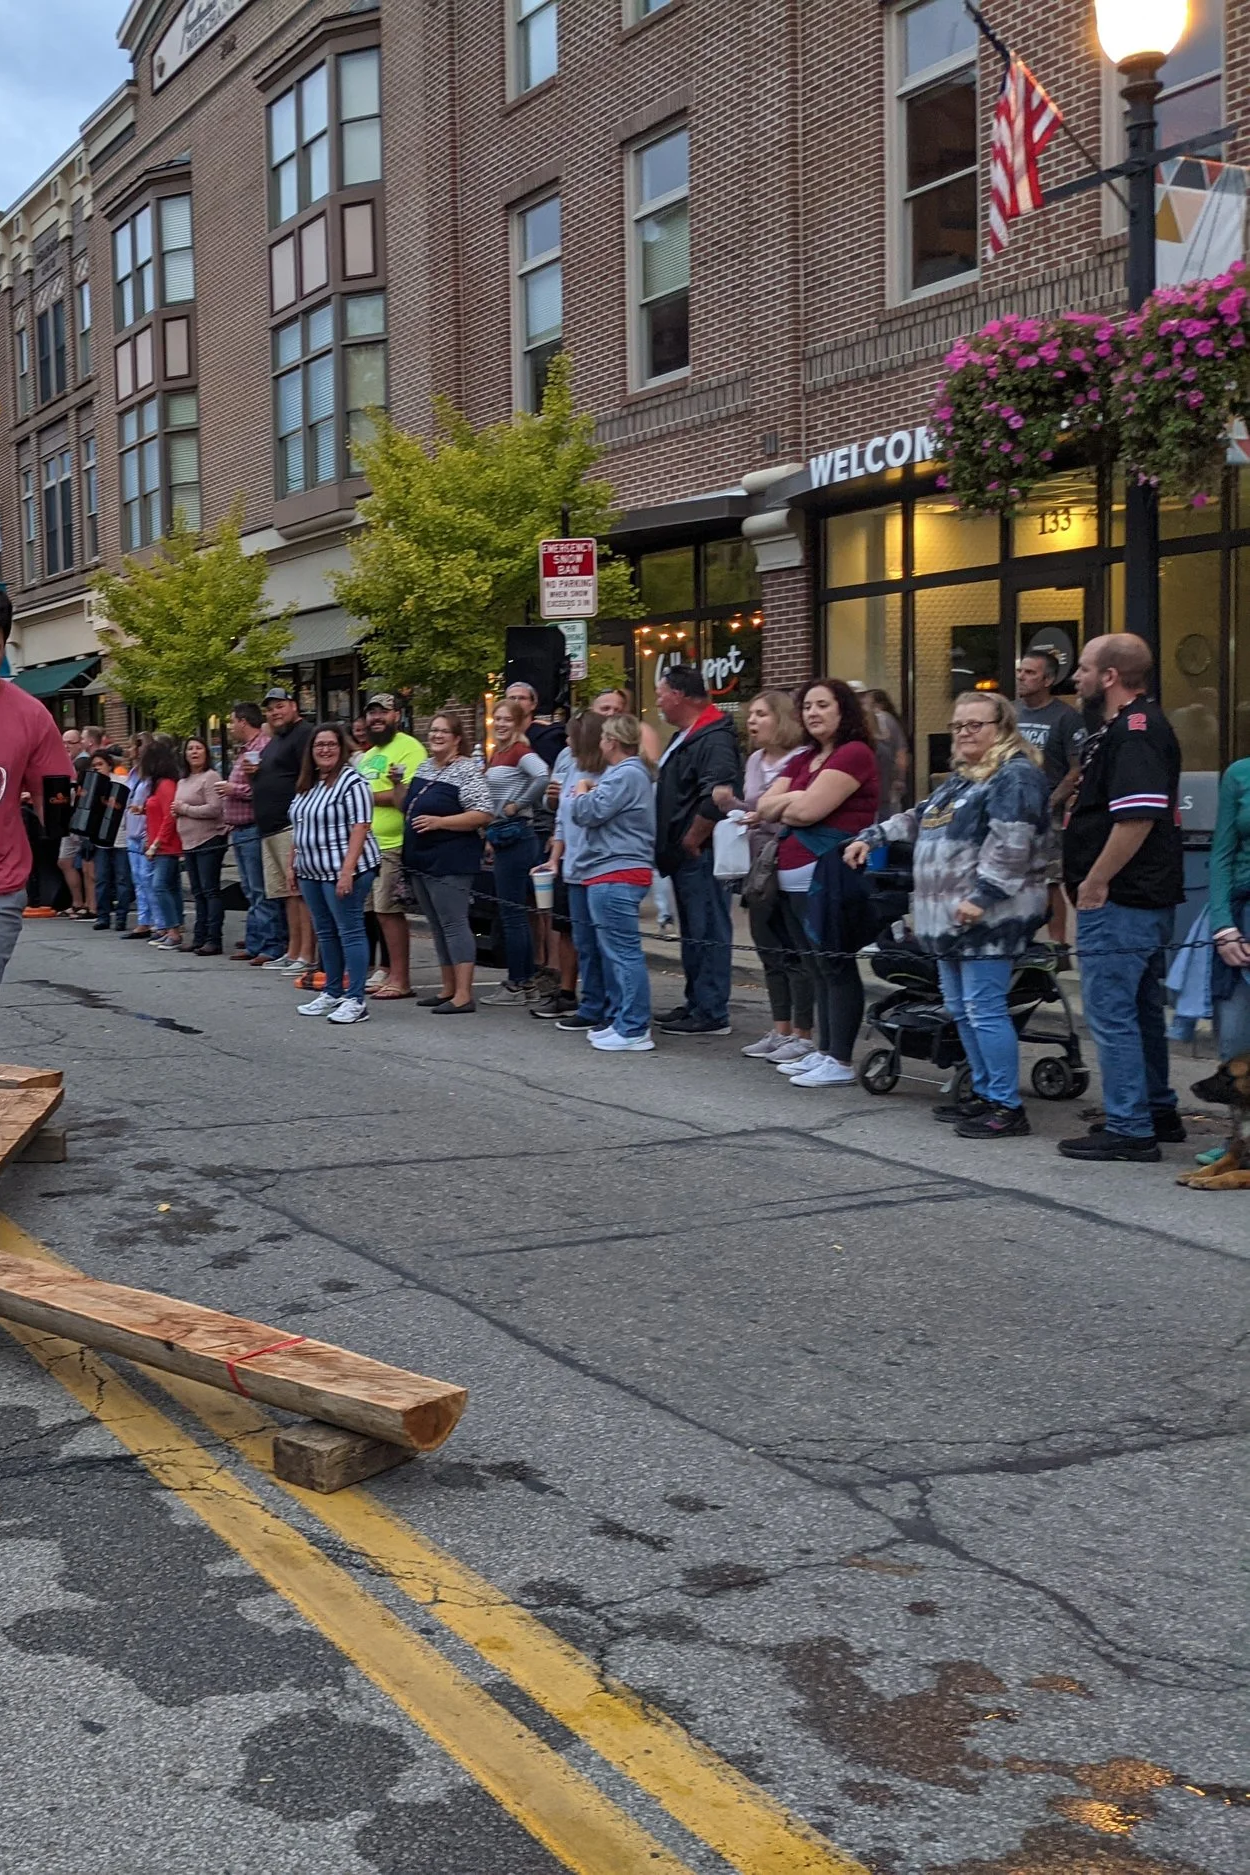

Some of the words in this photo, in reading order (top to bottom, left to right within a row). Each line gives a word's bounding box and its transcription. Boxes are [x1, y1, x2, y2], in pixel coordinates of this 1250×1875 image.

[809, 425, 936, 489] WELCOM
[1038, 507, 1072, 535] 133
[542, 543, 592, 554] EMERGENCY
[552, 553, 584, 564] SNOW
[557, 564, 580, 575] BAN
[545, 580, 557, 588] NO
[558, 579, 592, 587] PARKING
[1127, 713, 1147, 731] 2
